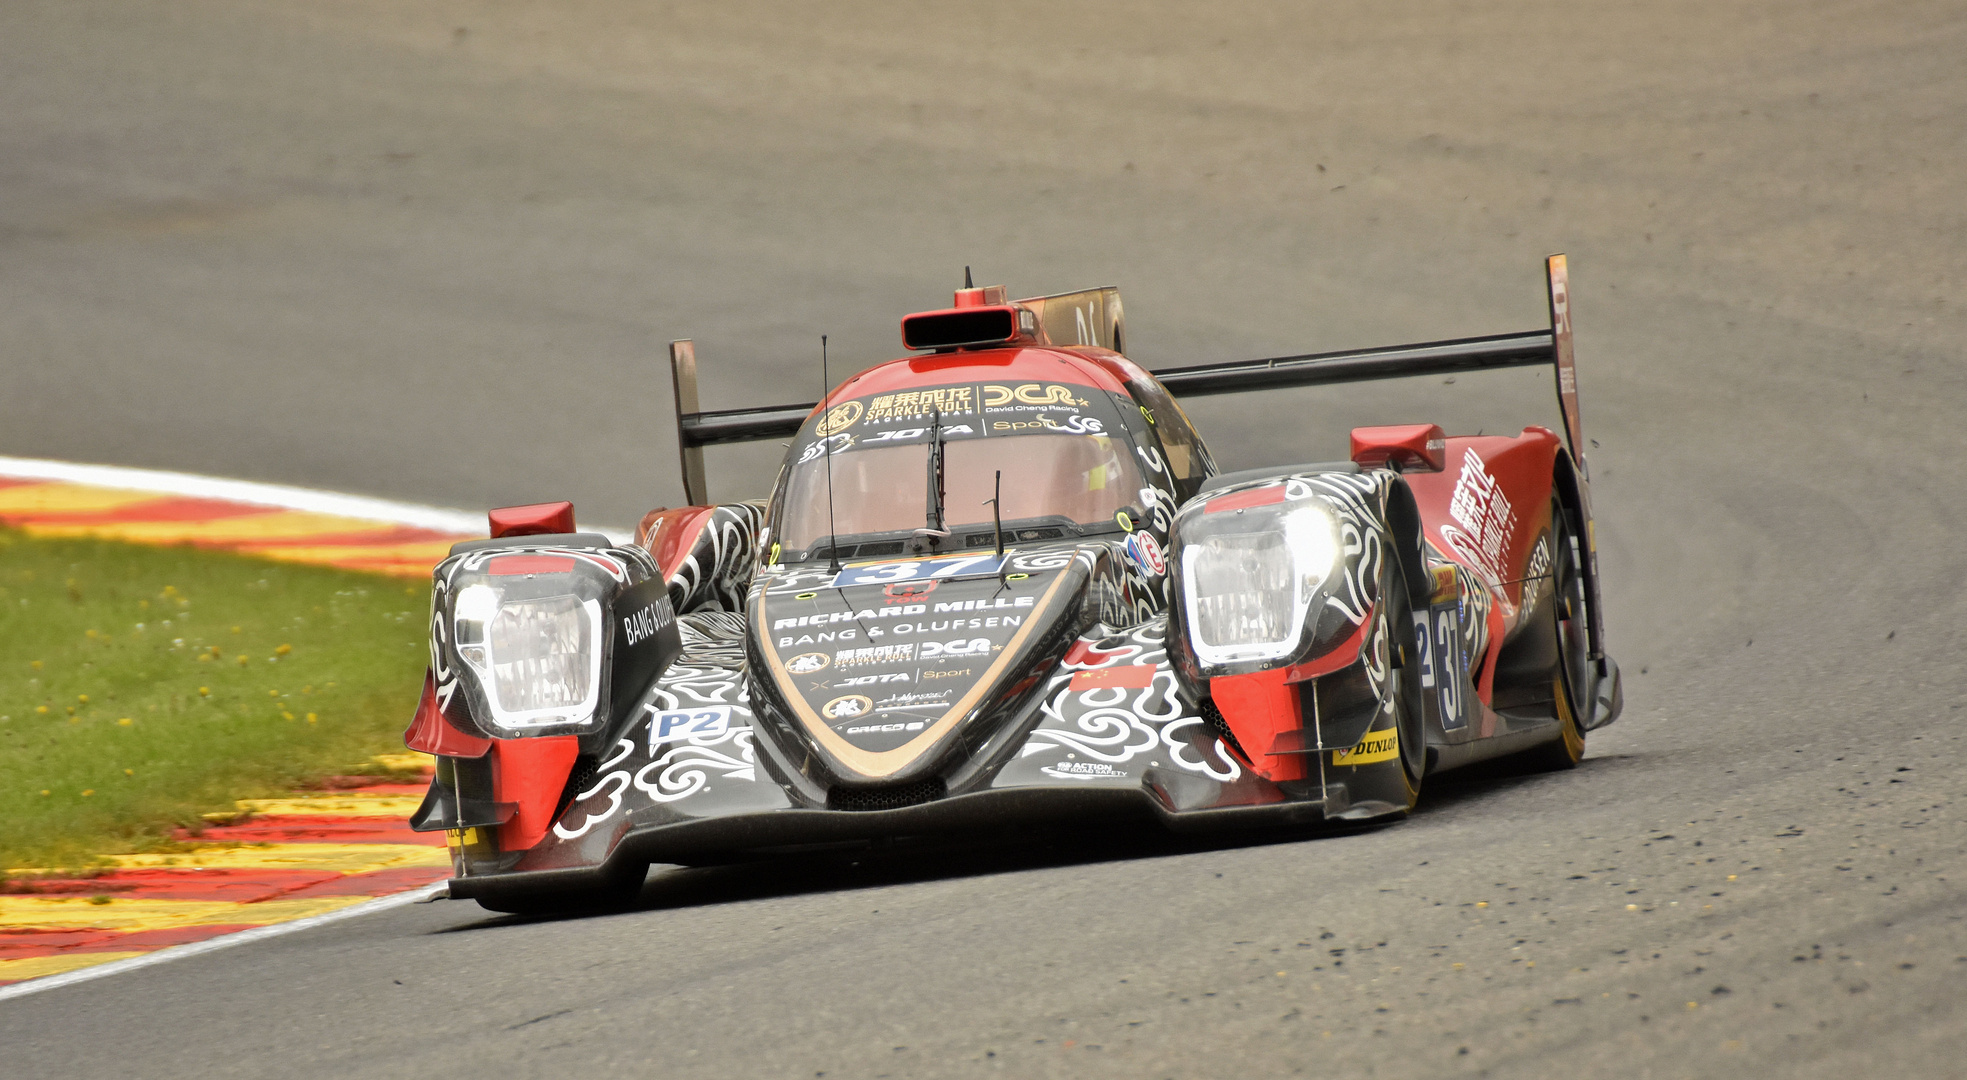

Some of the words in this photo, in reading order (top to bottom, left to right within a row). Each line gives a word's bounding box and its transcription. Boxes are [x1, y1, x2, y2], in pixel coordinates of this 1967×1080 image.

[865, 403, 931, 421] SPARKLE
[936, 400, 972, 412] ROLL
[985, 405, 1014, 413] David
[1048, 405, 1080, 413] Racing
[863, 413, 922, 426] JACKIE
[854, 554, 994, 583] 37
[884, 595, 929, 605] TOW
[773, 604, 926, 630] RICHARD
[933, 596, 1034, 613] MILLE
[624, 606, 654, 646] BANG
[778, 628, 856, 648] BANG
[867, 626, 884, 637] &
[893, 615, 1021, 634] OLUFSEN
[834, 655, 882, 666] SPARKLE
[884, 652, 912, 660] ROLL
[1438, 609, 1463, 722] 37
[833, 672, 910, 688] JOTA
[923, 668, 971, 679] Sport
[658, 711, 721, 738] P2
[1353, 736, 1396, 756] DUNLOP
[1072, 762, 1113, 771] ACTION
